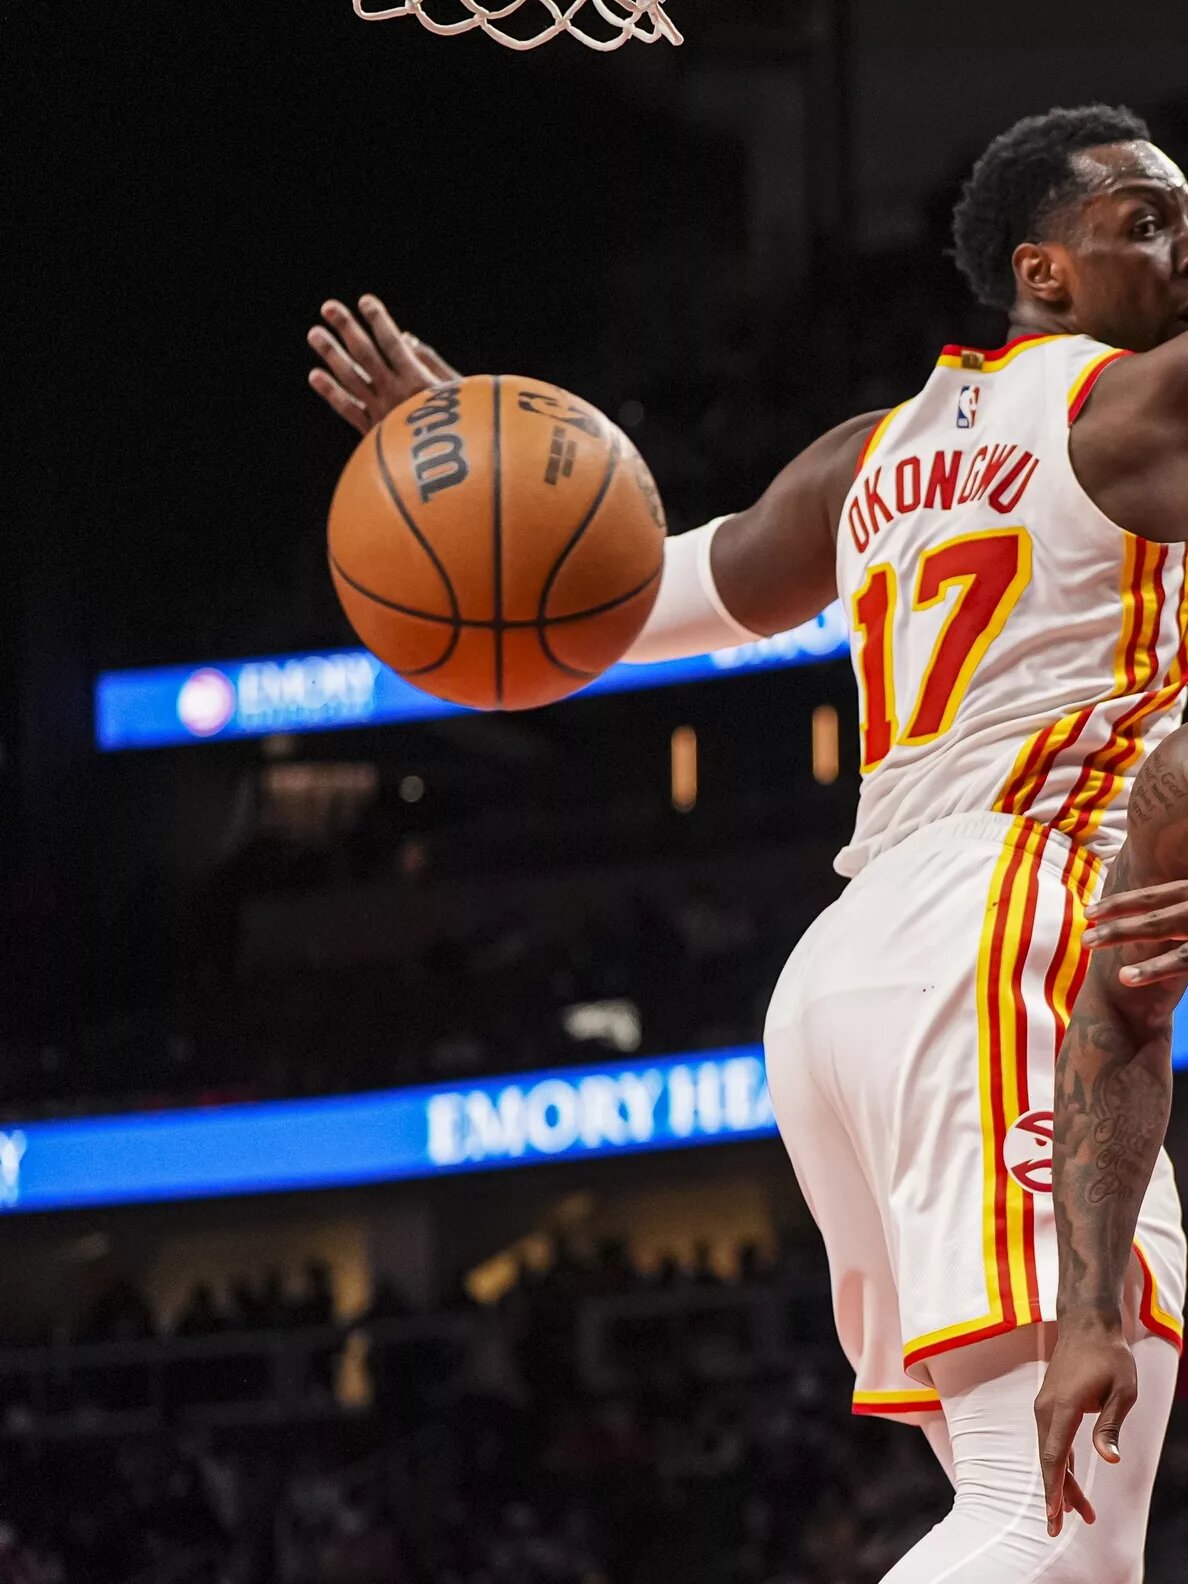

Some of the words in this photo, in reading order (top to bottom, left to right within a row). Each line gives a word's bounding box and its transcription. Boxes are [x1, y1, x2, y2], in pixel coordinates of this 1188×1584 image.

[848, 444, 1039, 553] OKONGWU
[852, 526, 1033, 774] 17
[427, 1067, 662, 1166] EMORY
